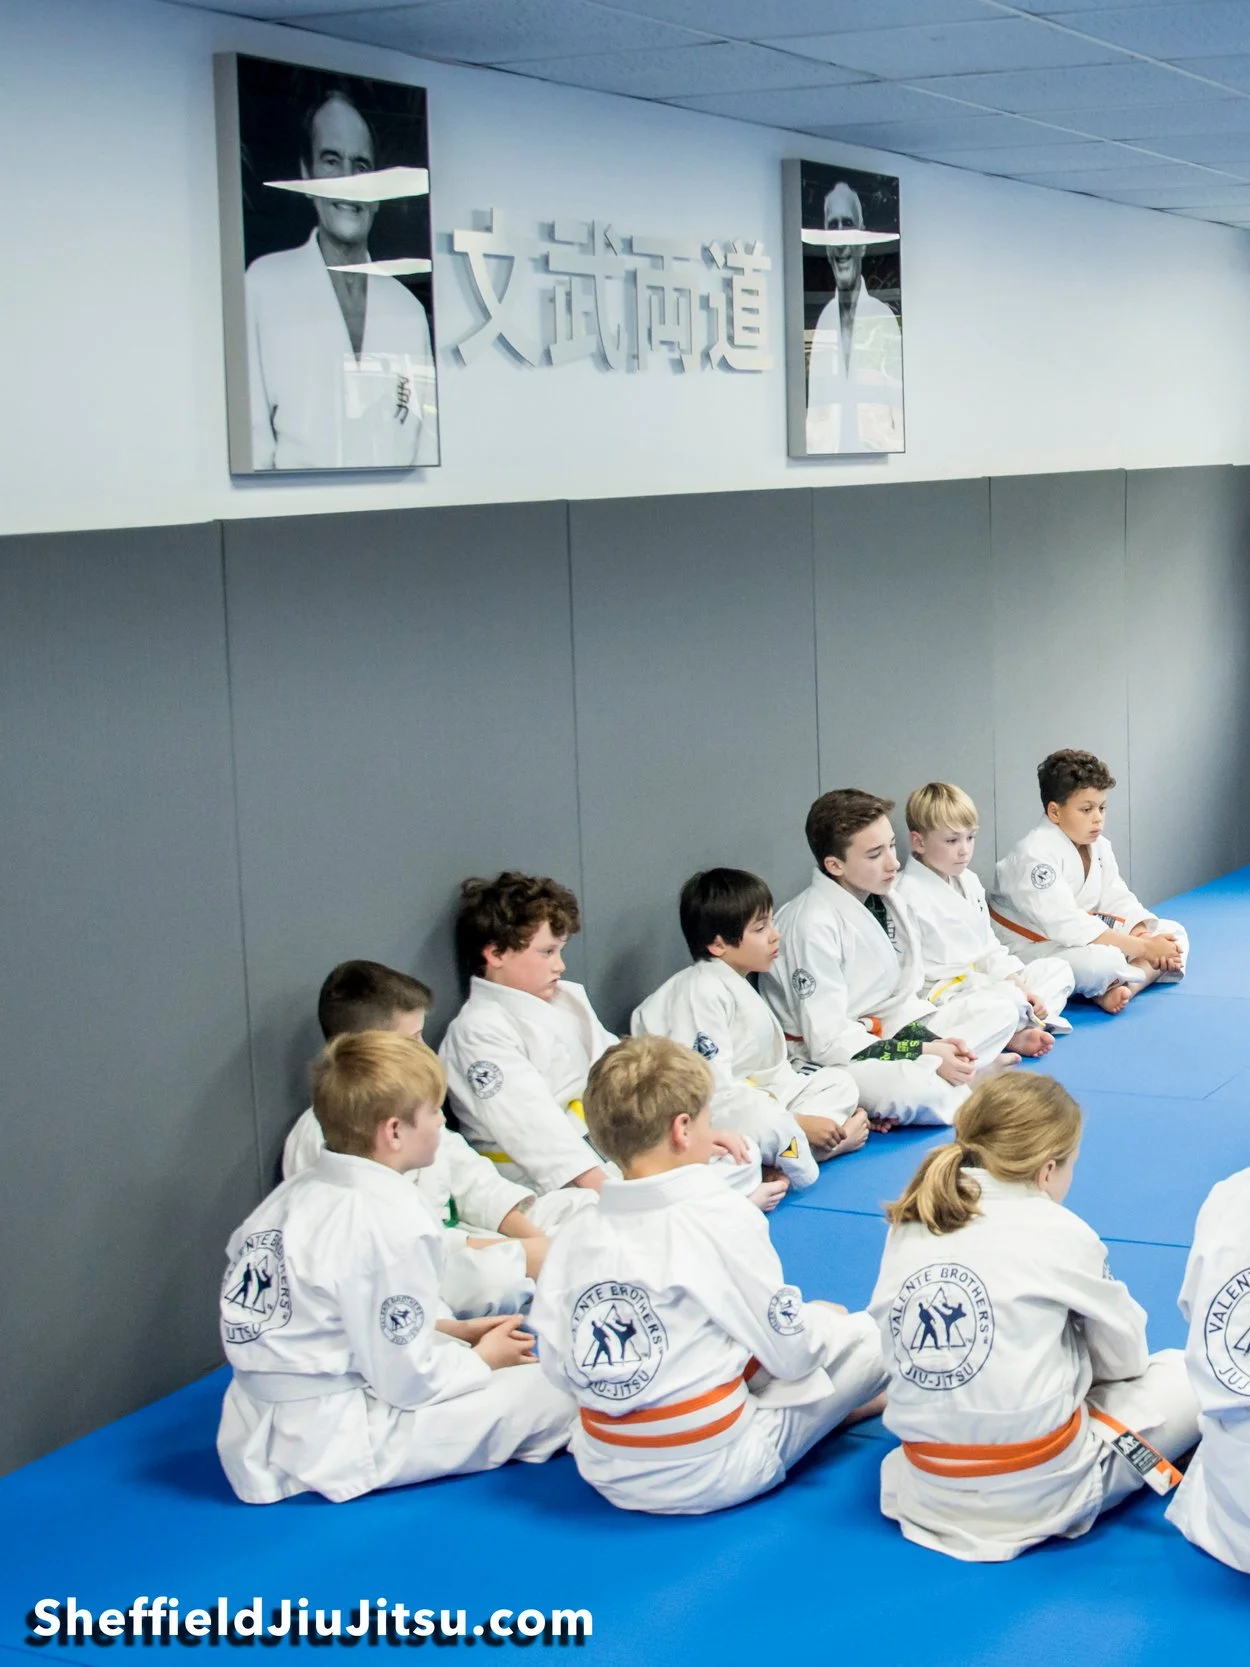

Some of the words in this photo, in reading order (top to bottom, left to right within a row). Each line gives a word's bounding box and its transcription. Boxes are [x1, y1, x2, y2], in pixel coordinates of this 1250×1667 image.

[893, 1270, 933, 1337] VALENTE
[940, 1267, 989, 1333] BROTHERS
[906, 1362, 974, 1387] JIU-JITSU
